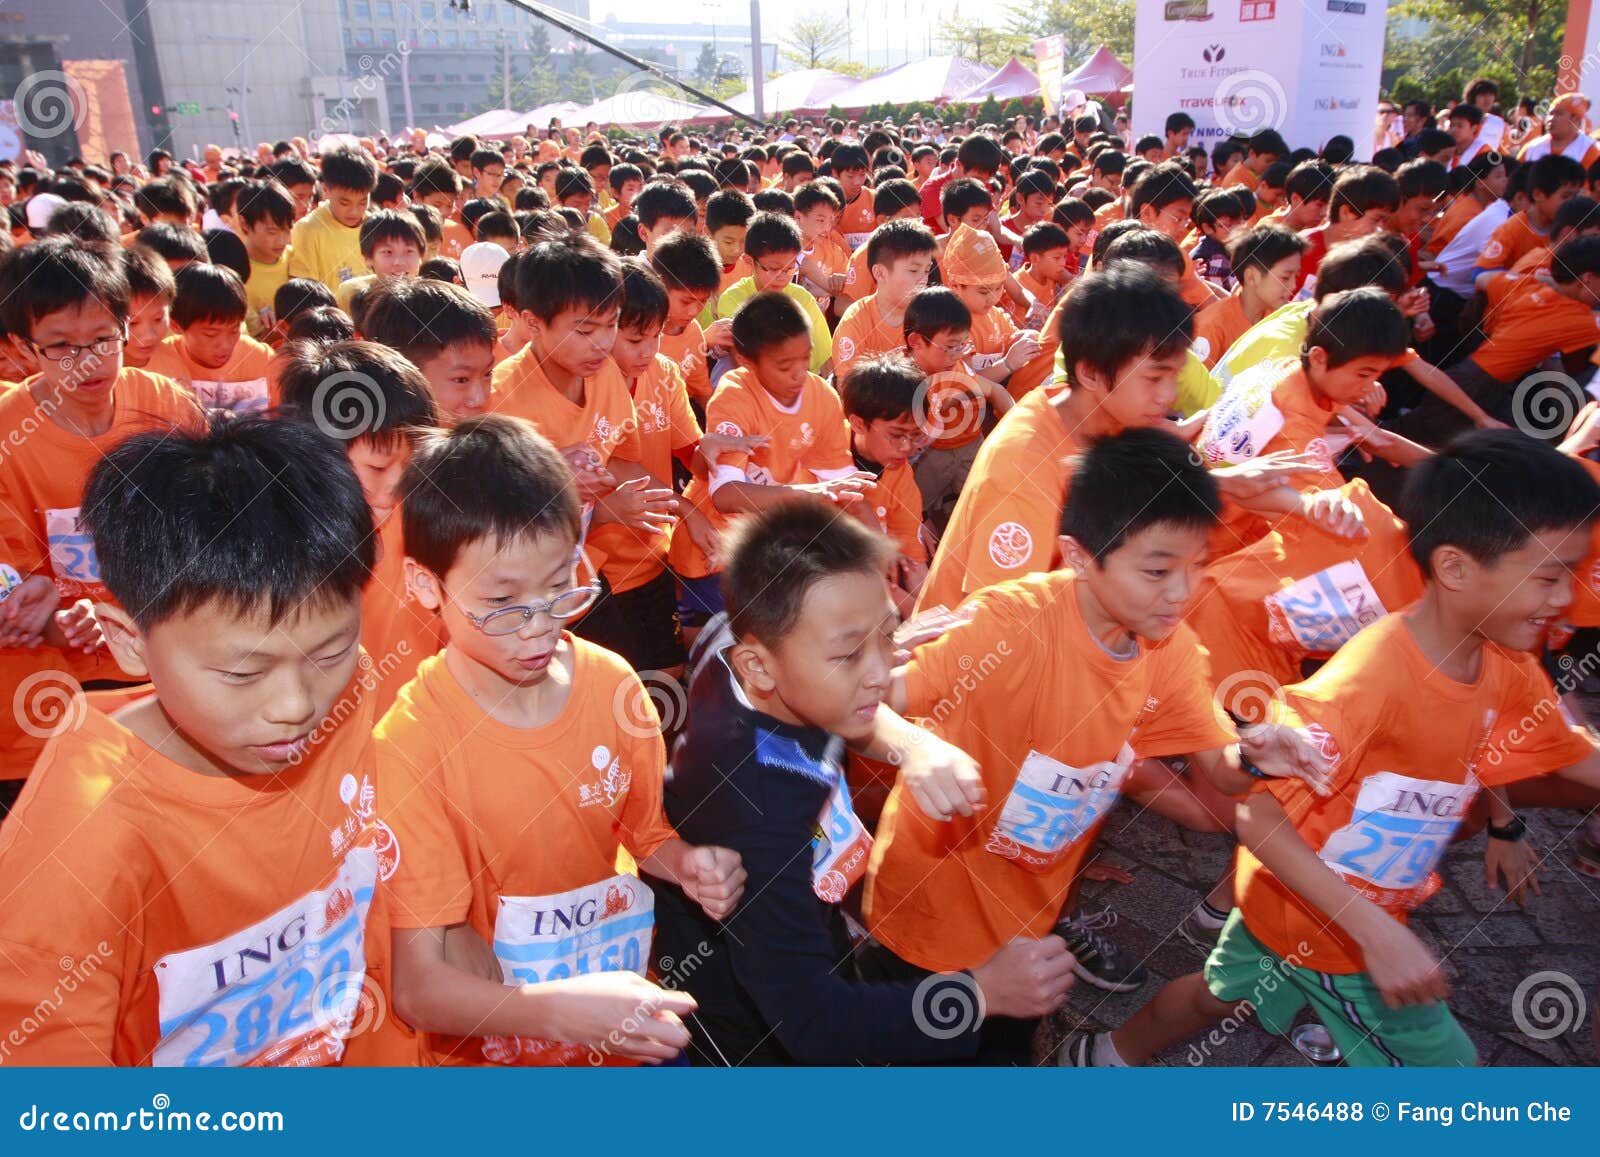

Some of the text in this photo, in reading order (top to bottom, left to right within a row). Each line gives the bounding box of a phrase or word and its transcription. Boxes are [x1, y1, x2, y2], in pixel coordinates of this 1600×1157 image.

[1209, 65, 1248, 78] FITNE
[1048, 770, 1112, 796] ING
[1390, 789, 1457, 818] ING
[530, 898, 598, 937] ING
[209, 913, 309, 993] ING
